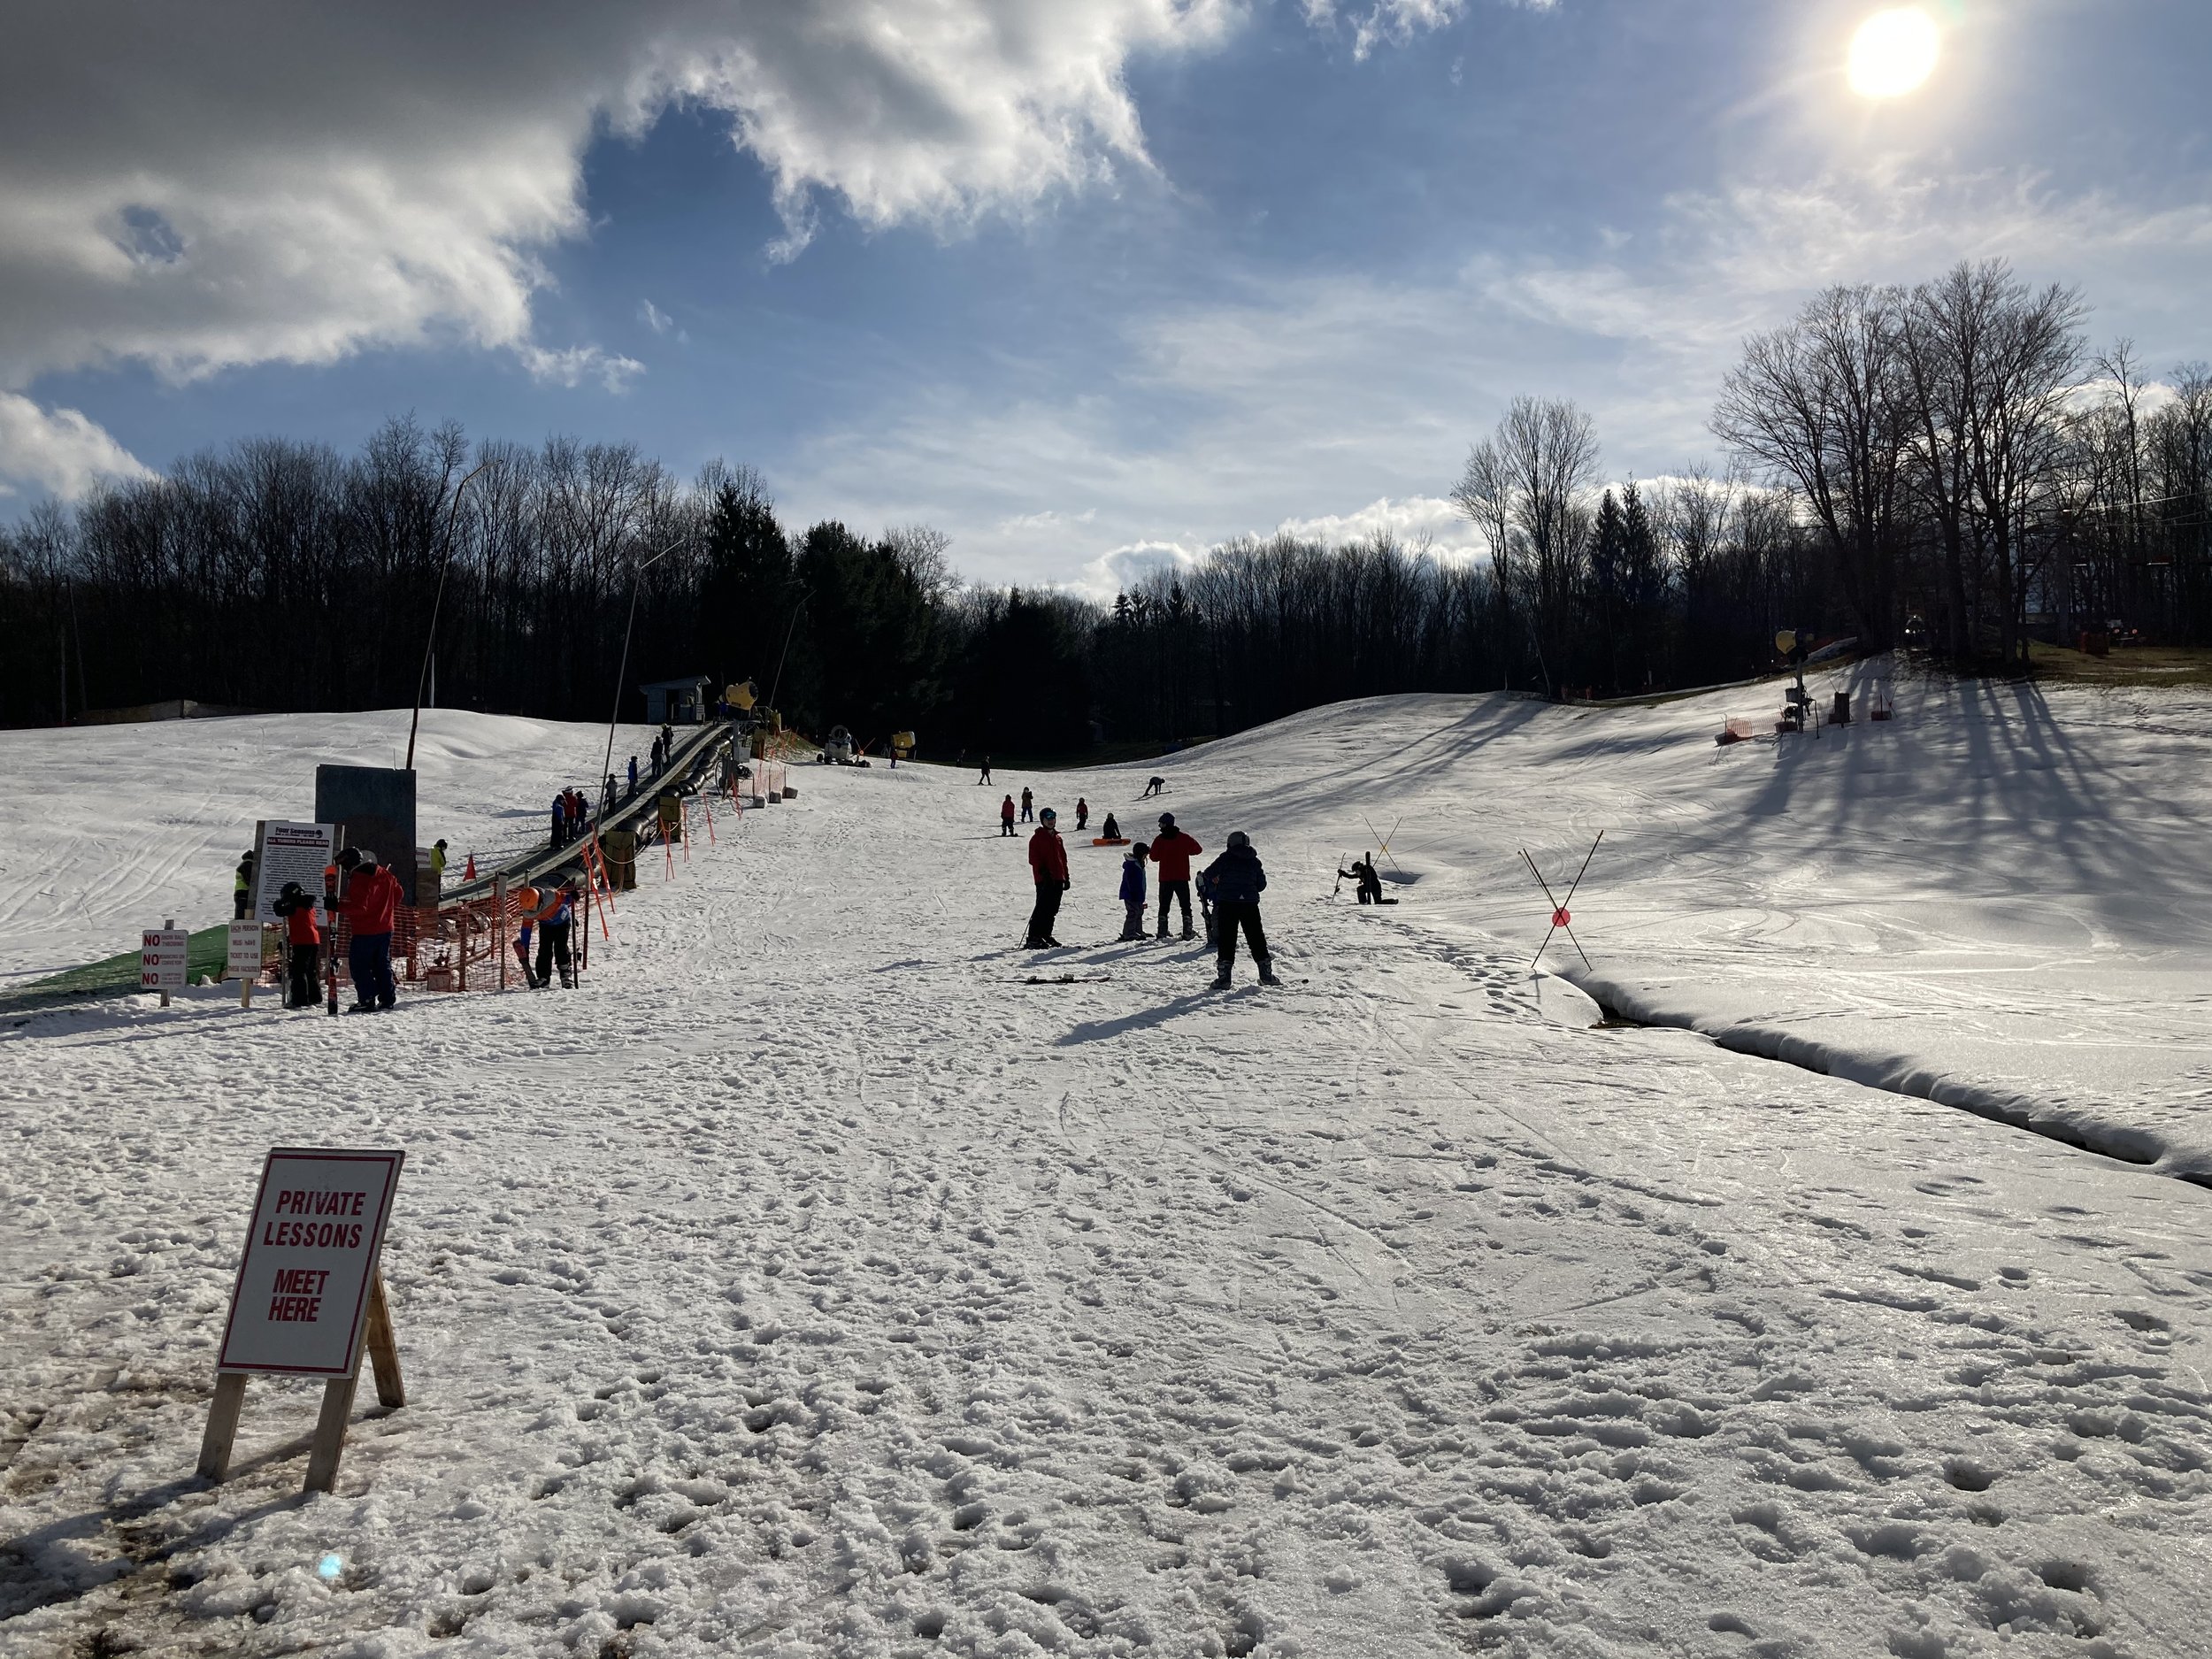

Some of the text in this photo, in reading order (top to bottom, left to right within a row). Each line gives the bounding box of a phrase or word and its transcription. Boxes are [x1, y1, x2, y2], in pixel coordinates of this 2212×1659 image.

[143, 934, 160, 947] NO
[142, 954, 159, 966] NO
[142, 972, 159, 985] NO
[275, 1190, 366, 1216] PRIVATE
[263, 1222, 363, 1248] LESSONS
[273, 1269, 330, 1294] MEET
[268, 1296, 322, 1322] HERE
